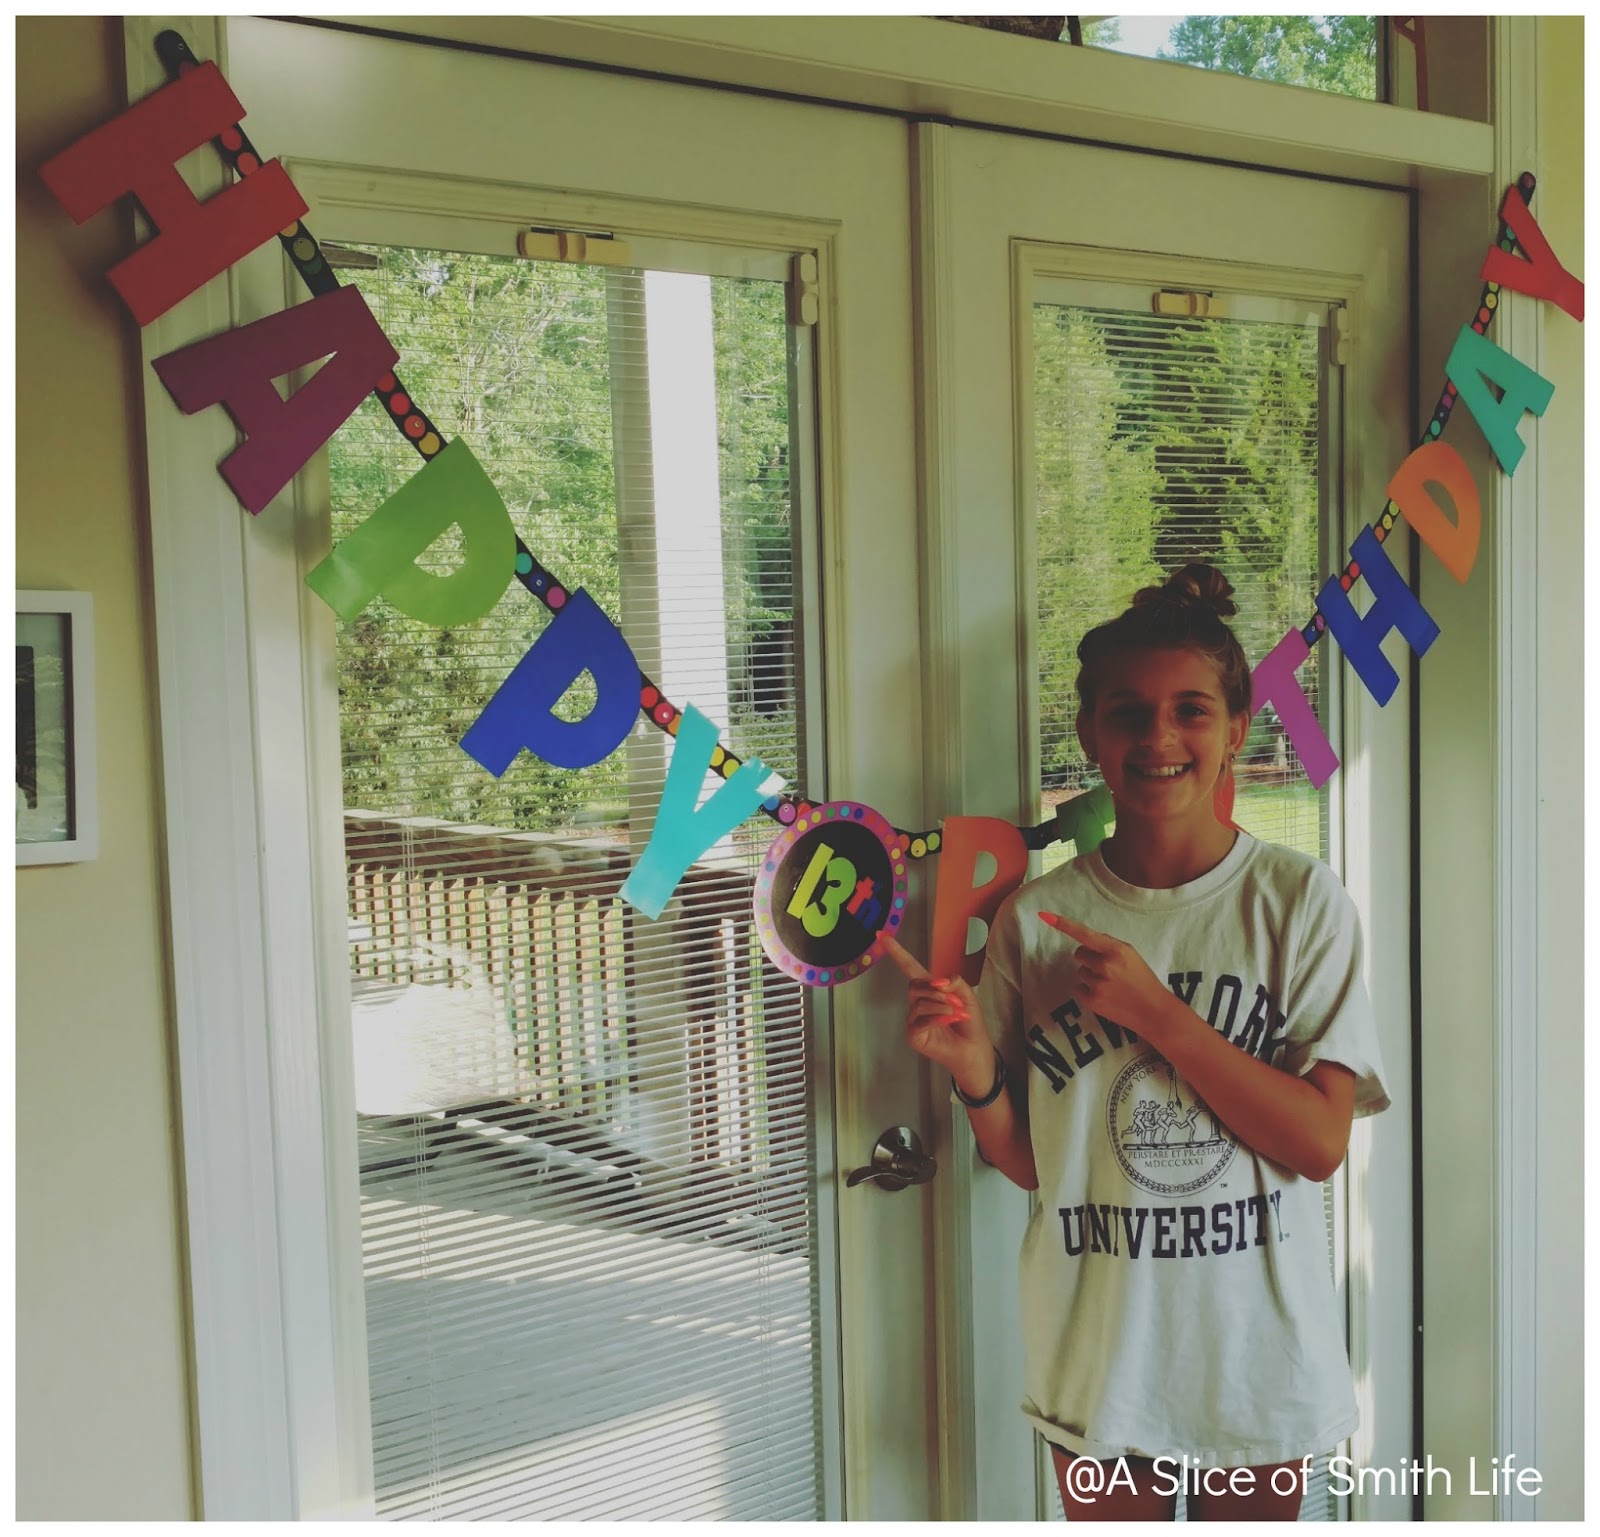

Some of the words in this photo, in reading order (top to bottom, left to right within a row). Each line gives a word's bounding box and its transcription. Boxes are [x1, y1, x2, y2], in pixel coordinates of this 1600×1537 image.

[37, 59, 787, 921] HAPPY
[786, 843, 882, 938] 13th
[931, 183, 1585, 987] BTHDAY
[1120, 1082, 1135, 1104] NEW
[1128, 1149, 1169, 1159] PERSTARE
[1171, 1149, 1181, 1158] ET
[1144, 1158, 1204, 1168] MDCCCXXXI
[1058, 1190, 1284, 1260] UNIVERSITY
